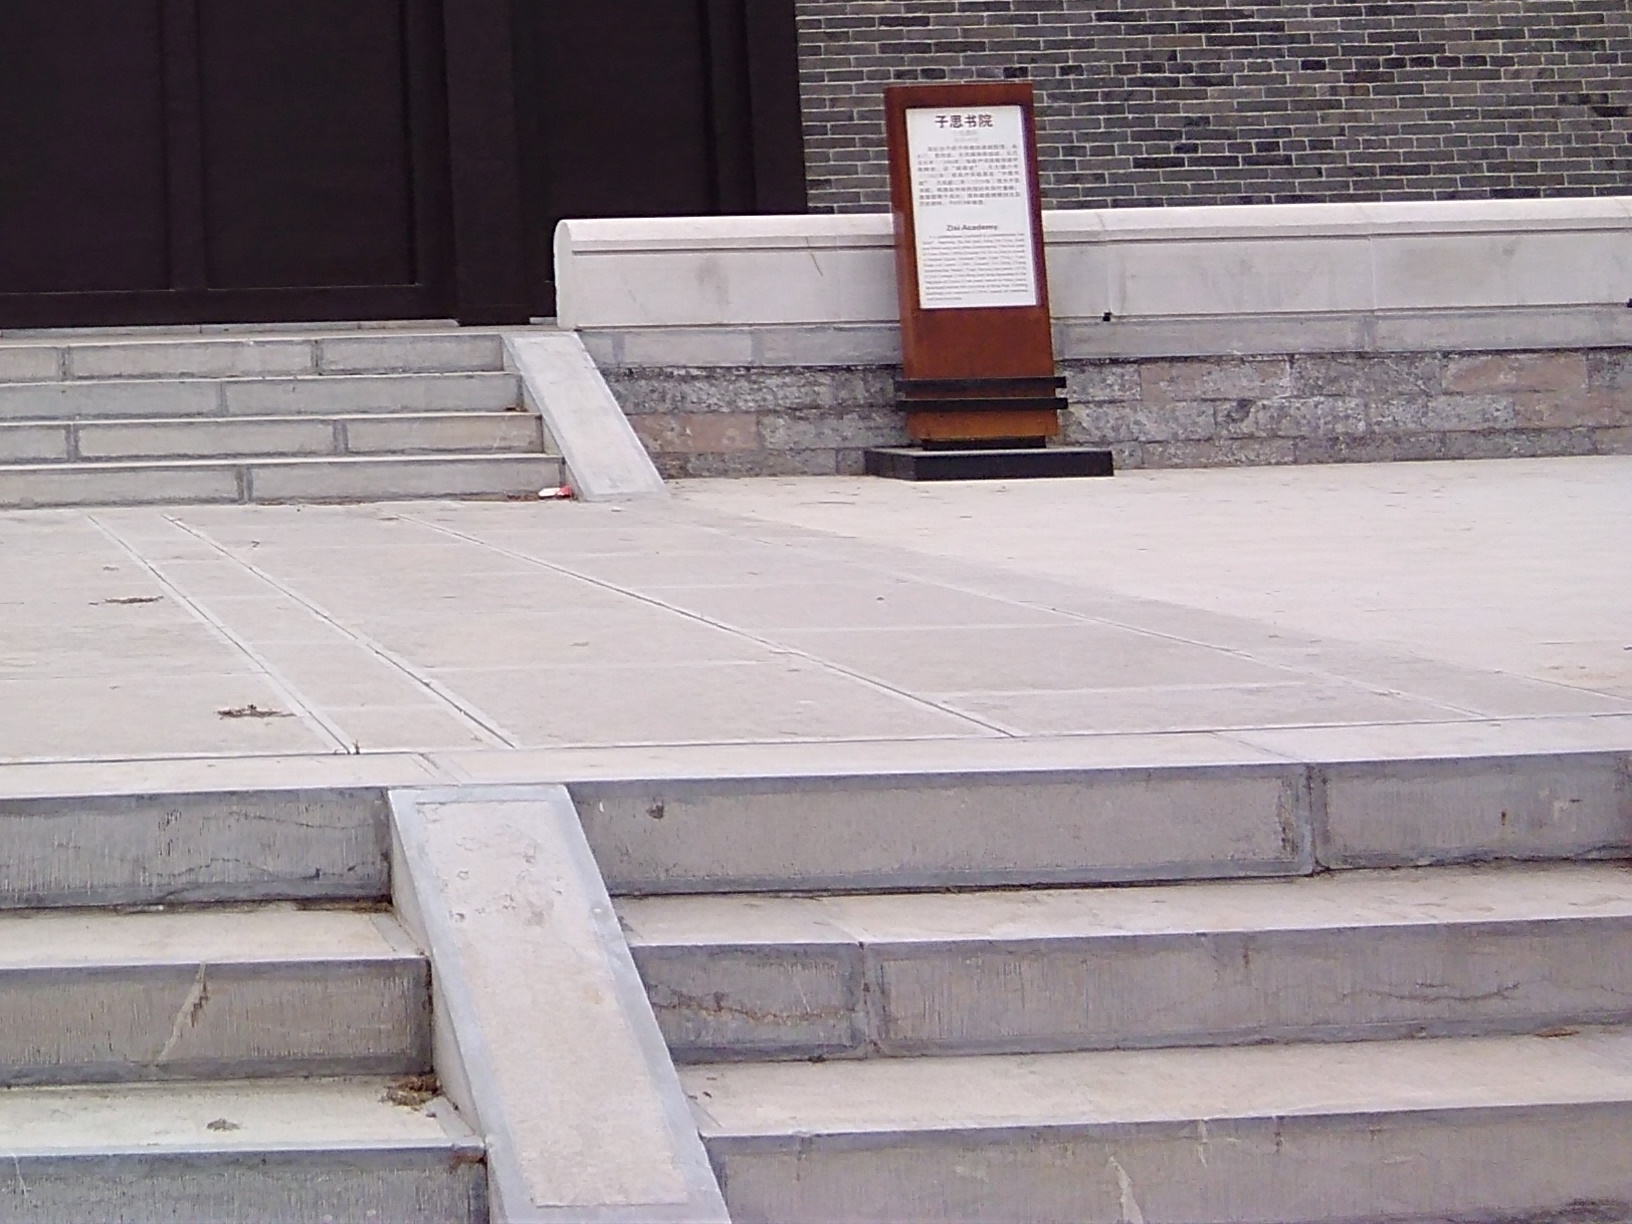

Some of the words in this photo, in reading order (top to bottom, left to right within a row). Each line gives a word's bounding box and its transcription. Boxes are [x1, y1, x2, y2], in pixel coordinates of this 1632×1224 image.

[934, 114, 994, 129] 子思书院
[962, 223, 998, 232] Academy
